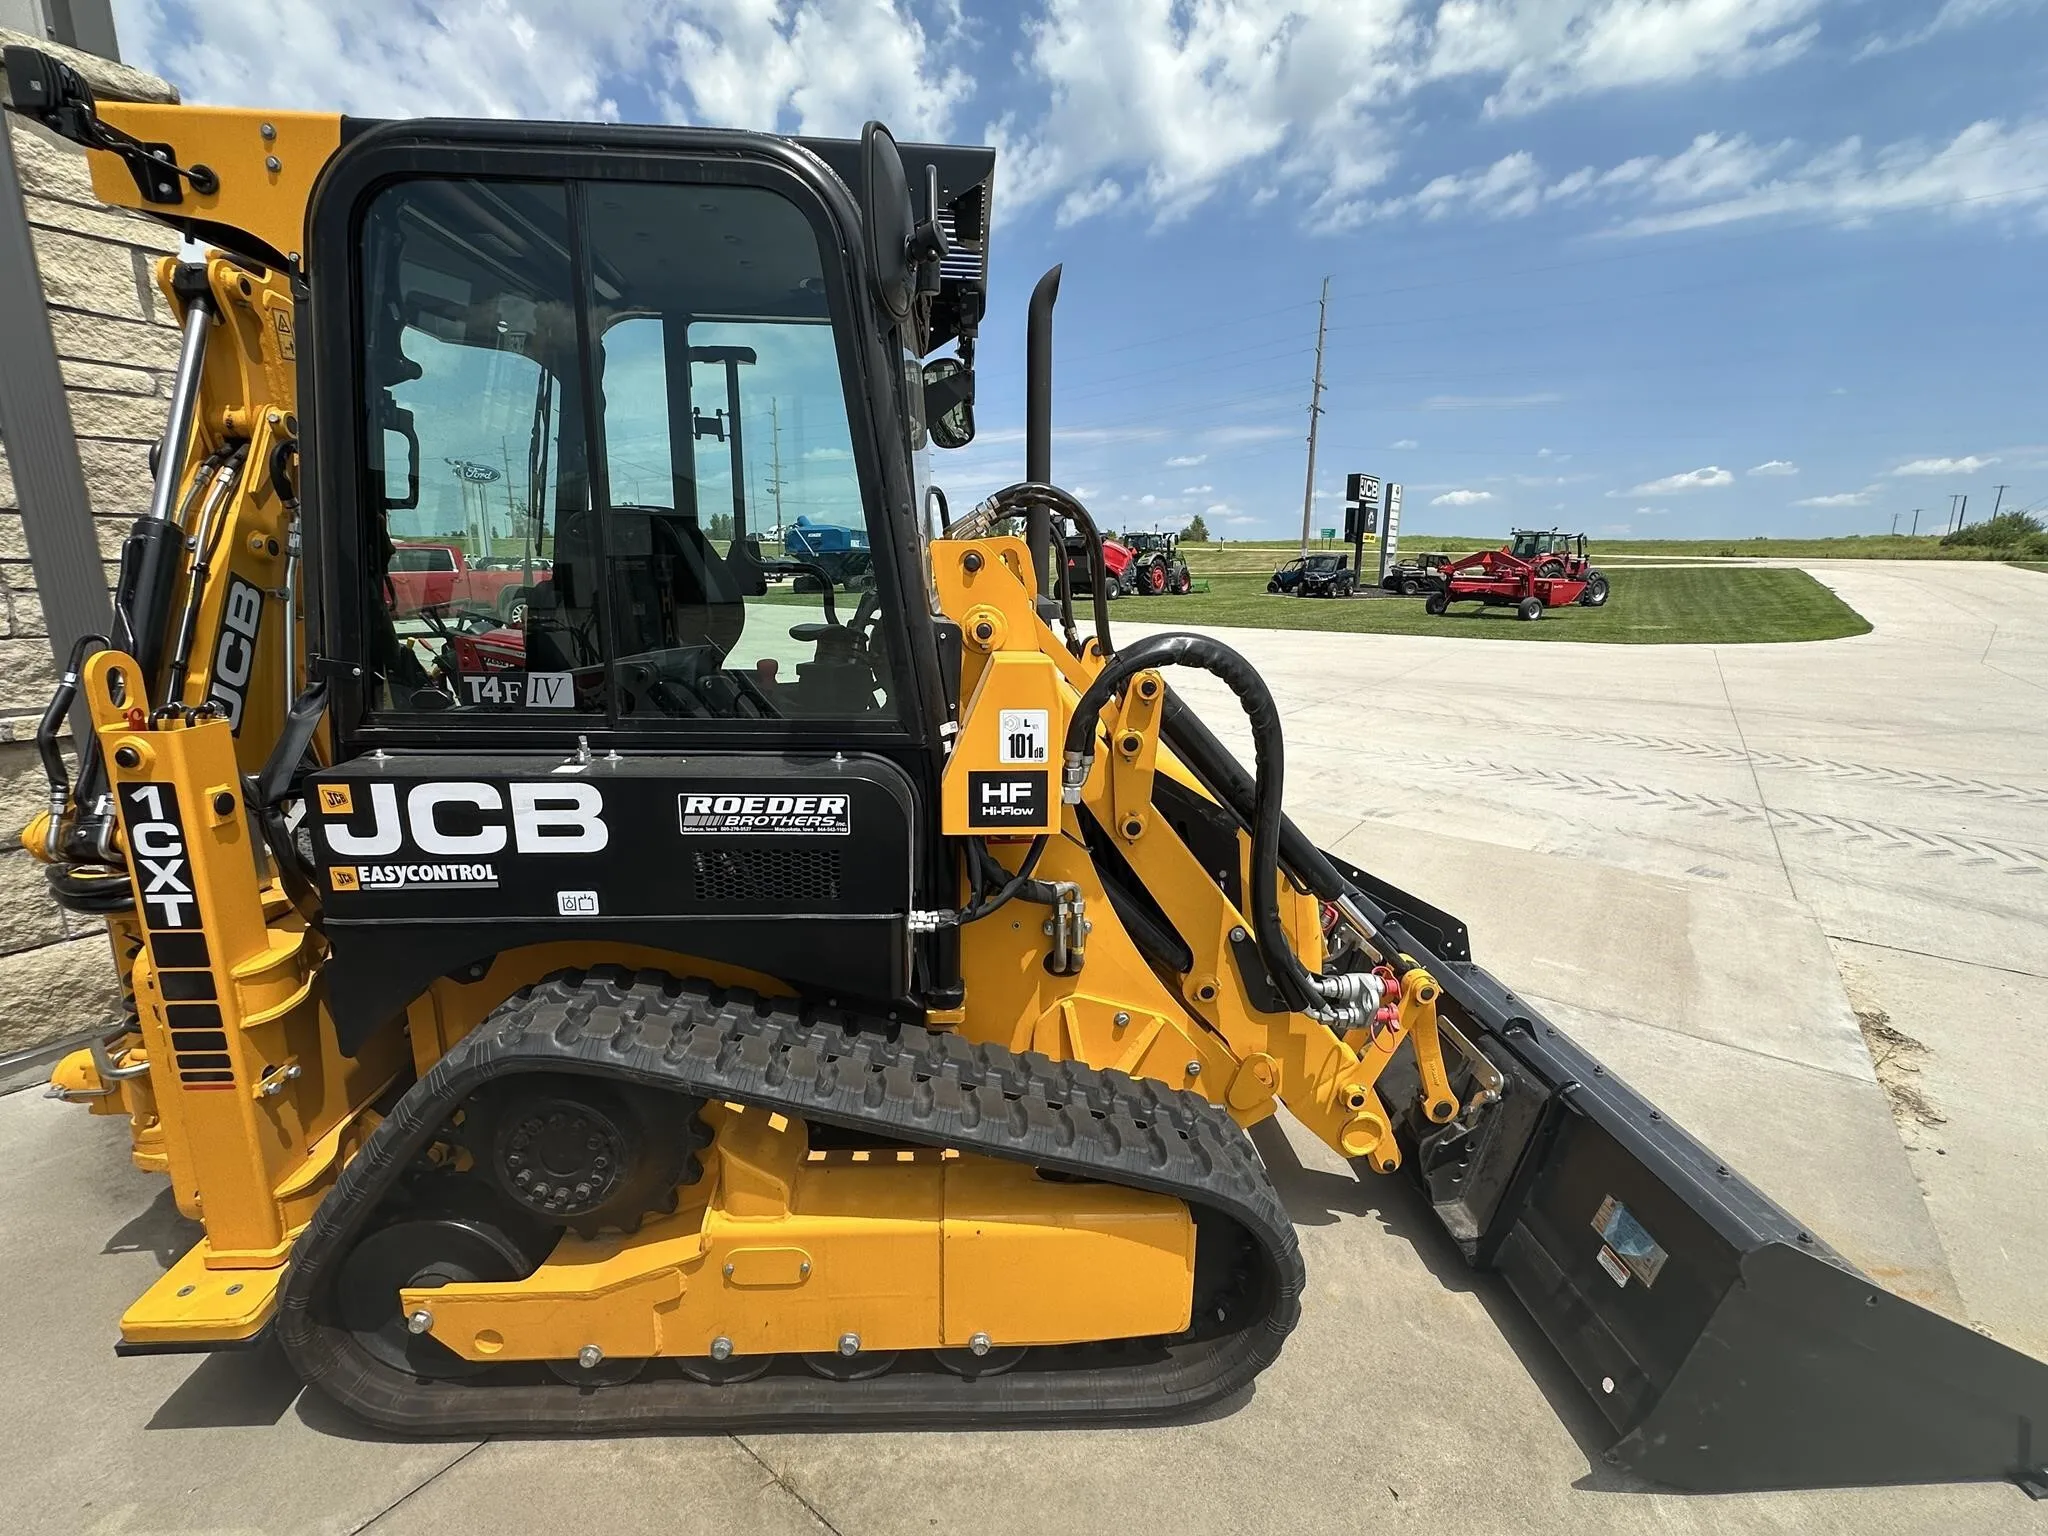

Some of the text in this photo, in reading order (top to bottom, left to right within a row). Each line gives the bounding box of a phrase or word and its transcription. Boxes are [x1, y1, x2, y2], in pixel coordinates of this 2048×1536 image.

[465, 466, 493, 480] Ford
[1360, 477, 1378, 496] JCB
[211, 581, 261, 731] JCB
[530, 677, 564, 705] IV
[1008, 733, 1044, 759] 101 dB
[325, 791, 348, 807] JCB
[982, 782, 1033, 804] HF
[684, 796, 846, 814] ROEDER
[982, 806, 1034, 816] Hi-Flow
[324, 782, 608, 855] JCB
[724, 815, 837, 826] BROTHERS
[130, 785, 194, 927] 1CXT
